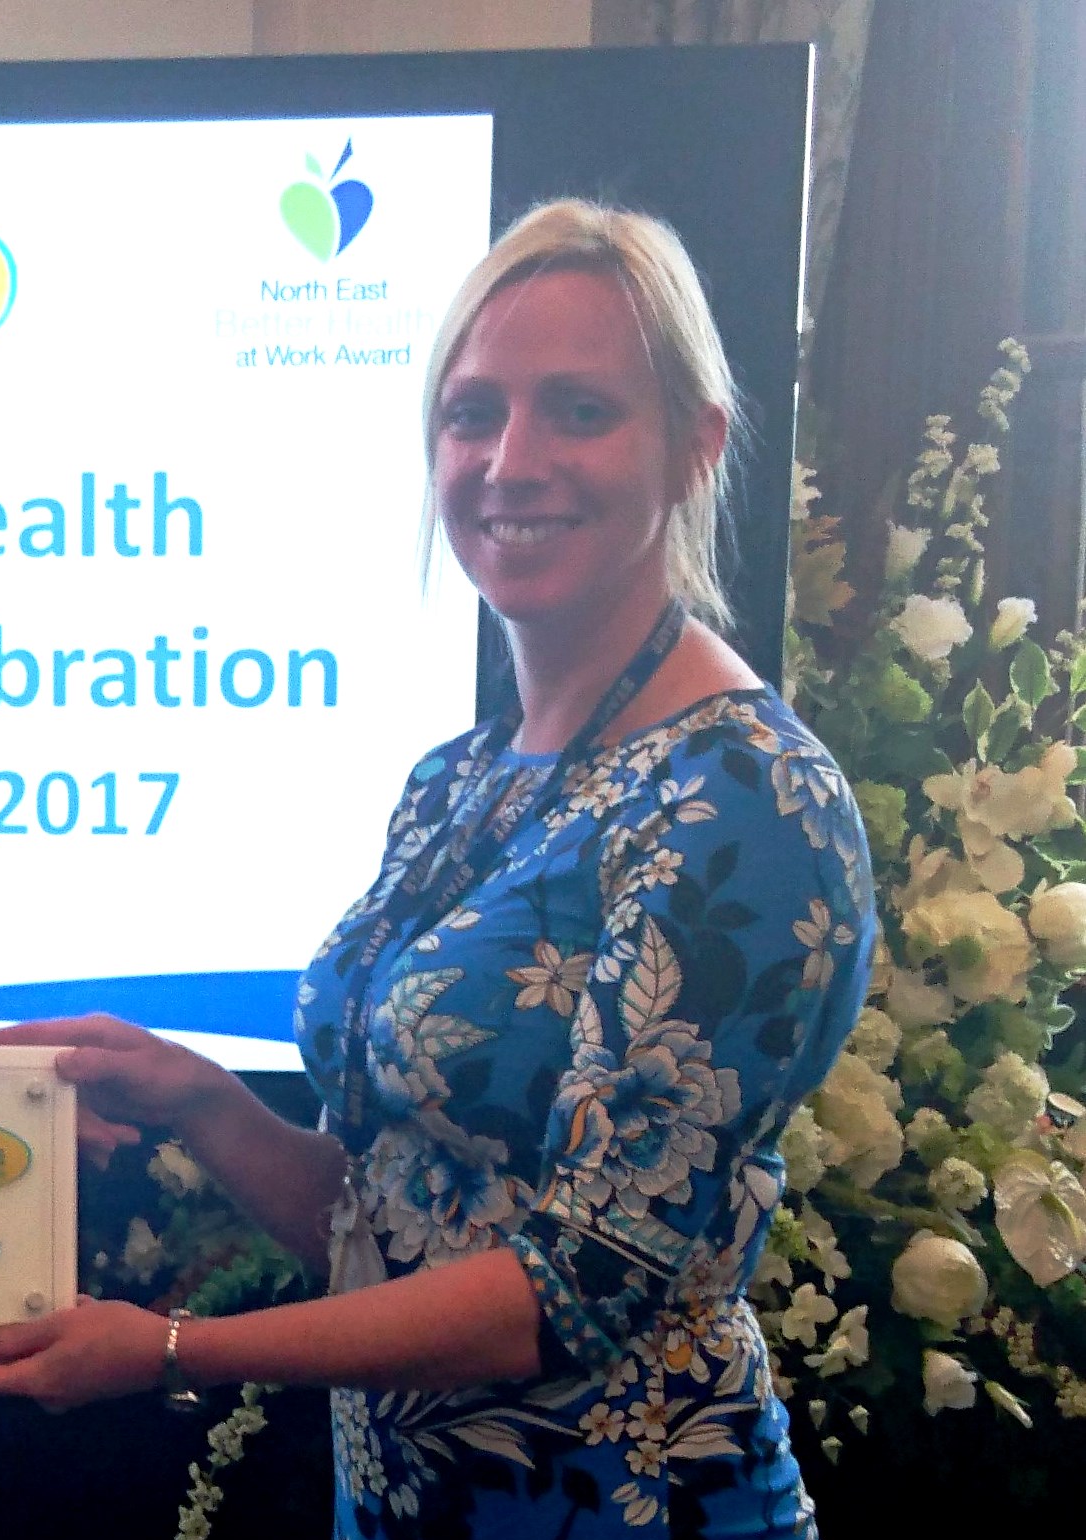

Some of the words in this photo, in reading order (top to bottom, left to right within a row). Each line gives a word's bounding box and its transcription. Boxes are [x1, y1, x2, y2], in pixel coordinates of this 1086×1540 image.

[261, 279, 328, 302] North
[336, 278, 388, 301] East
[235, 347, 257, 367] at
[264, 345, 326, 367] Work
[334, 343, 412, 366] Award
